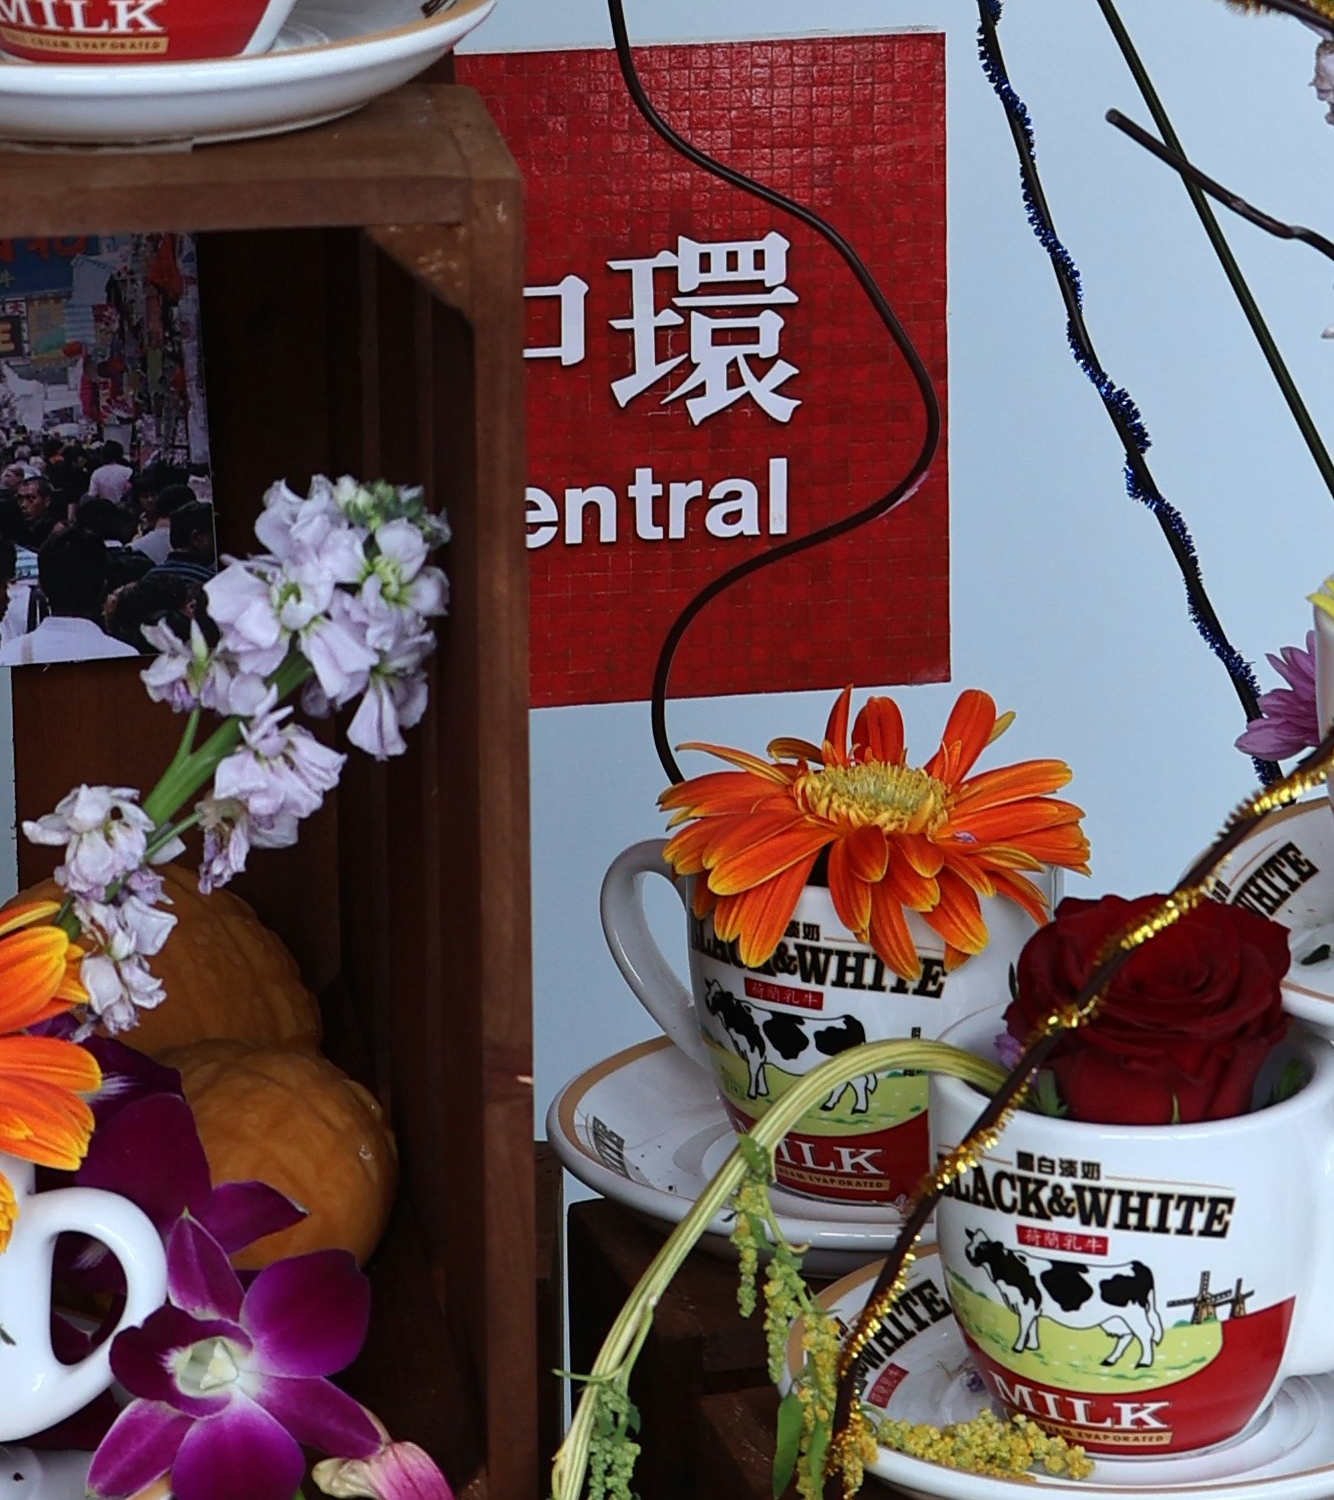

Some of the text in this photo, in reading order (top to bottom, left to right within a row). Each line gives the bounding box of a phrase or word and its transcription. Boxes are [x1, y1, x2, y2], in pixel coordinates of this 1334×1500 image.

[525, 458, 789, 550] entral
[775, 1136, 885, 1176] ILK
[1016, 1150, 1101, 1181] 黑白淡奶
[988, 1369, 1171, 1431] MILK
